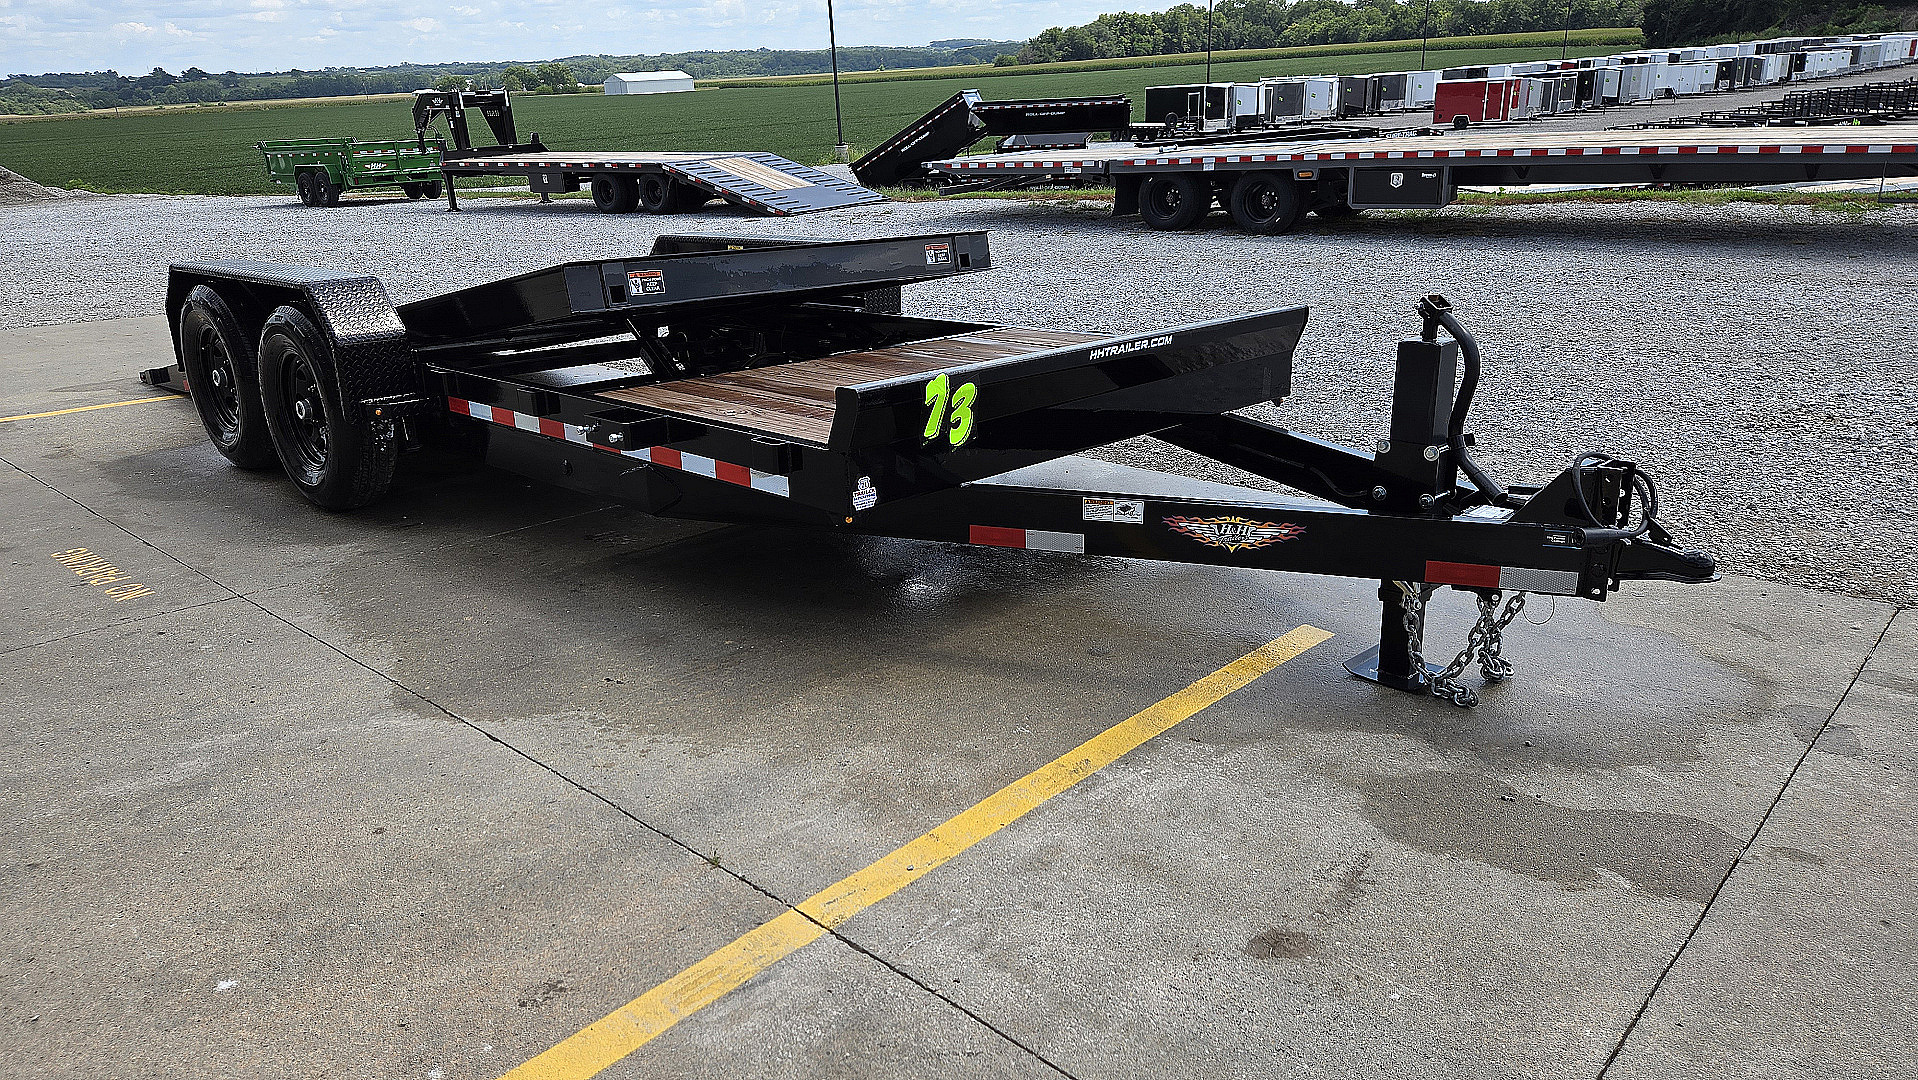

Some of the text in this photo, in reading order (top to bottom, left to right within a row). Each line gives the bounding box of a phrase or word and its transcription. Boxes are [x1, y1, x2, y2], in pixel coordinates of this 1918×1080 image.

[1089, 334, 1173, 361] HHTRAILER.COM
[1218, 523, 1250, 536] H&H
[51, 546, 156, 602] NO PARKING
